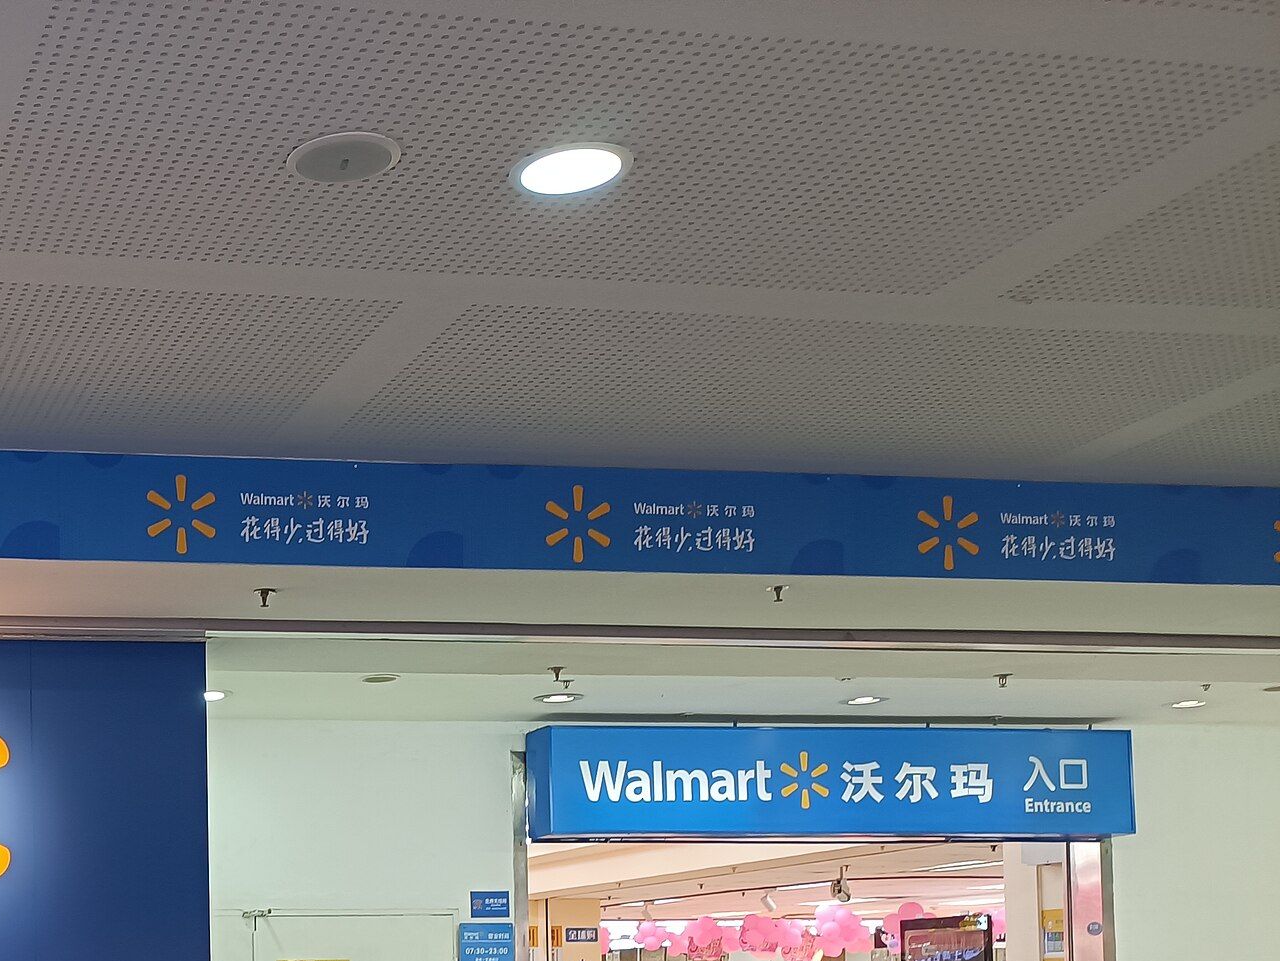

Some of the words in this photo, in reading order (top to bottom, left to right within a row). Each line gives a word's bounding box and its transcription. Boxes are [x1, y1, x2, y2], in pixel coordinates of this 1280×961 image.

[240, 492, 295, 506] Walmart
[317, 495, 369, 509] 沃尔玛
[634, 502, 685, 516] Walmart
[706, 504, 755, 518] 沃尔玛
[1000, 512, 1048, 526] Walmart
[1069, 514, 1115, 528] 沃尔玛
[579, 760, 772, 803] Walmart
[840, 761, 995, 803] 沃尔玛
[1023, 756, 1088, 792] 入口
[1024, 798, 1092, 814] Entrance
